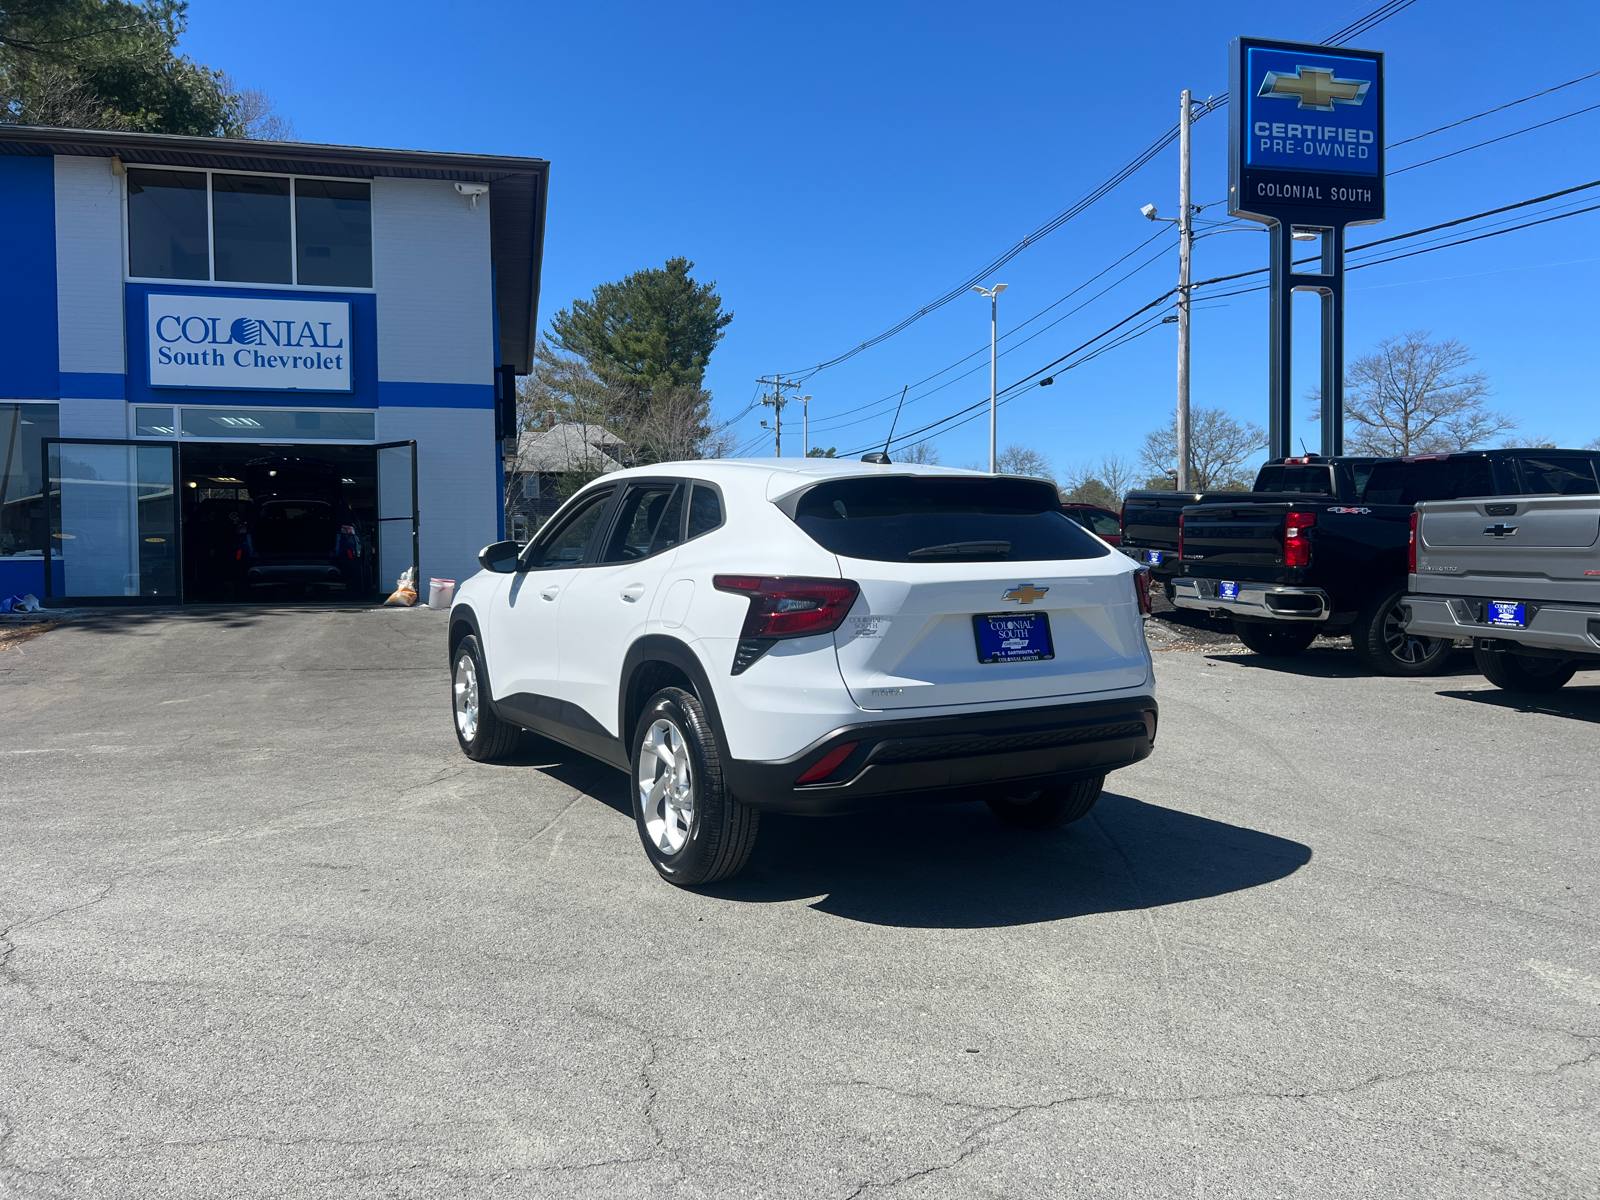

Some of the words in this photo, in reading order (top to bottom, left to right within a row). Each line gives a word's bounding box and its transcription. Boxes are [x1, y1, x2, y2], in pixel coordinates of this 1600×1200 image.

[1254, 121, 1374, 144] CERTIFIED
[1260, 138, 1369, 159] PRE-OWNED
[1257, 182, 1322, 200] COLONIAL
[1330, 187, 1372, 202] SOUTH
[156, 315, 344, 349] COLONIAL
[158, 345, 226, 367] South
[233, 348, 344, 370] Chevrolet
[849, 616, 883, 624] COLONIAL
[990, 620, 1034, 631] COLONIAL
[998, 629, 1029, 639] SOUTH
